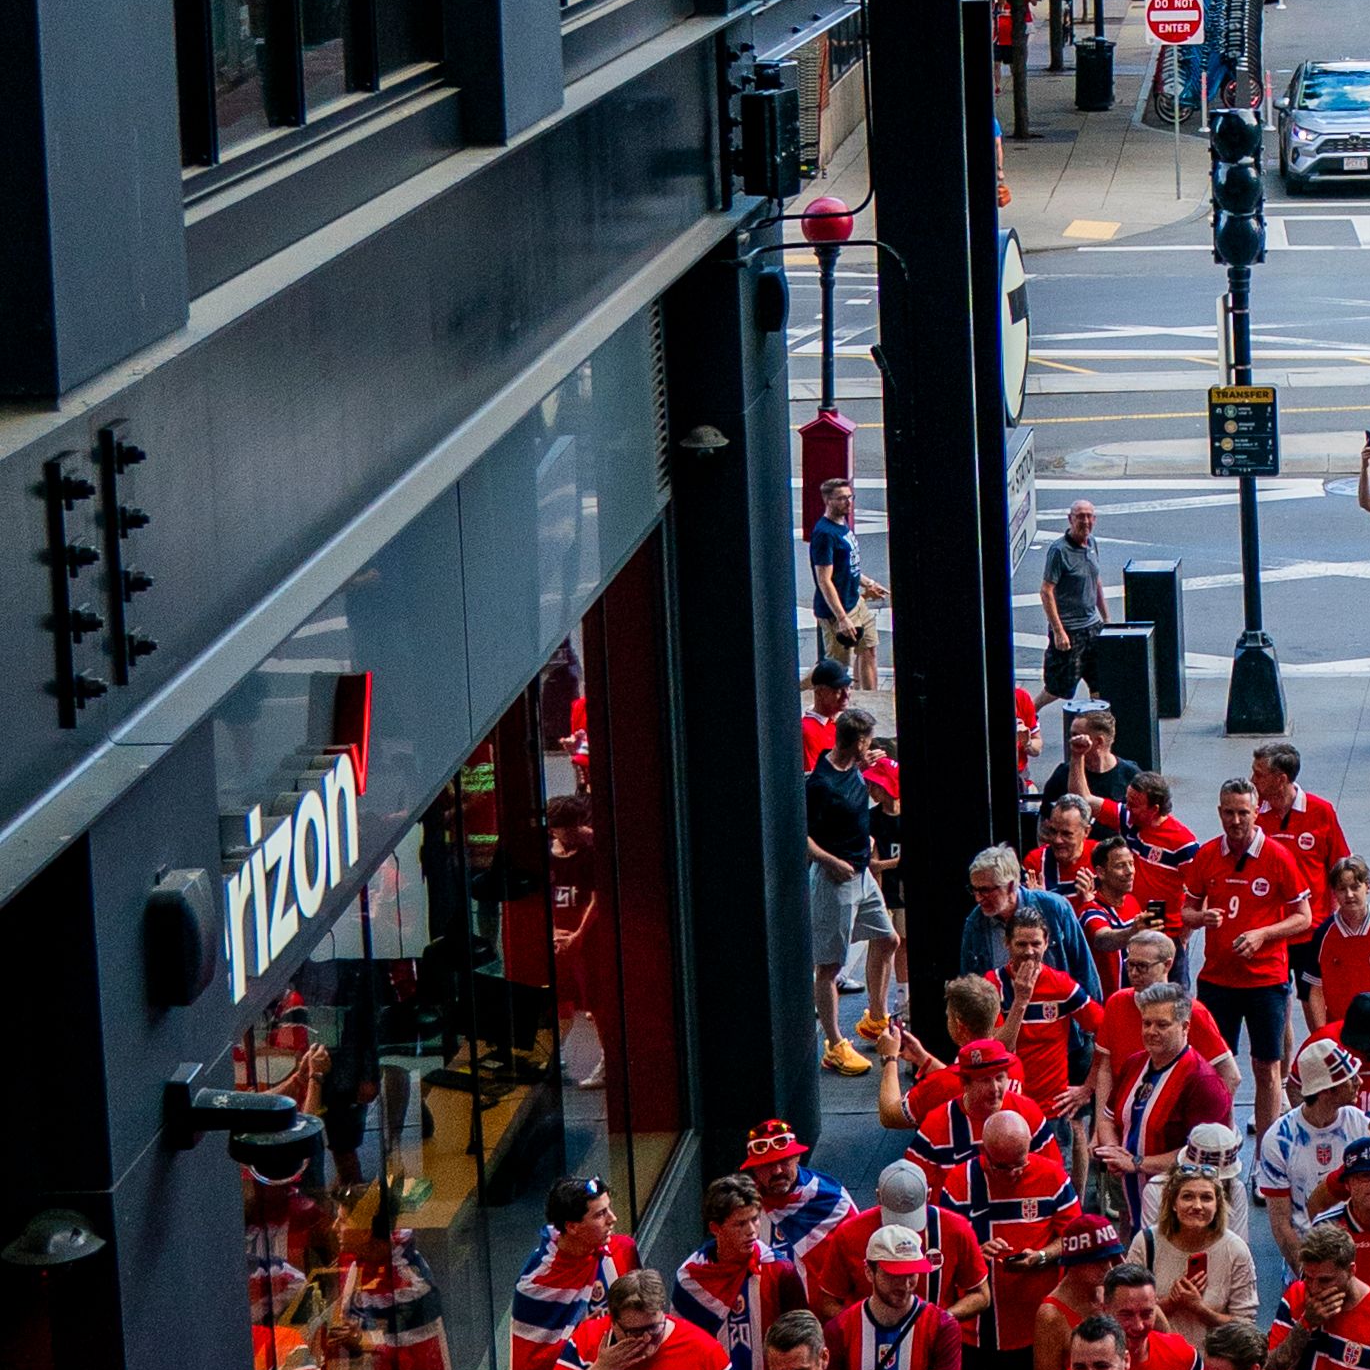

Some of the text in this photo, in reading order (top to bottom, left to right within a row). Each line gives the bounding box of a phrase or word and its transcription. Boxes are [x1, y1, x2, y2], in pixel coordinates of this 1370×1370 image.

[1158, 23, 1191, 33] ENTER
[1215, 390, 1270, 399] TRANSFER
[224, 752, 360, 1006] rizon
[1227, 895, 1240, 919] 9
[1062, 1224, 1119, 1252] FOR NO
